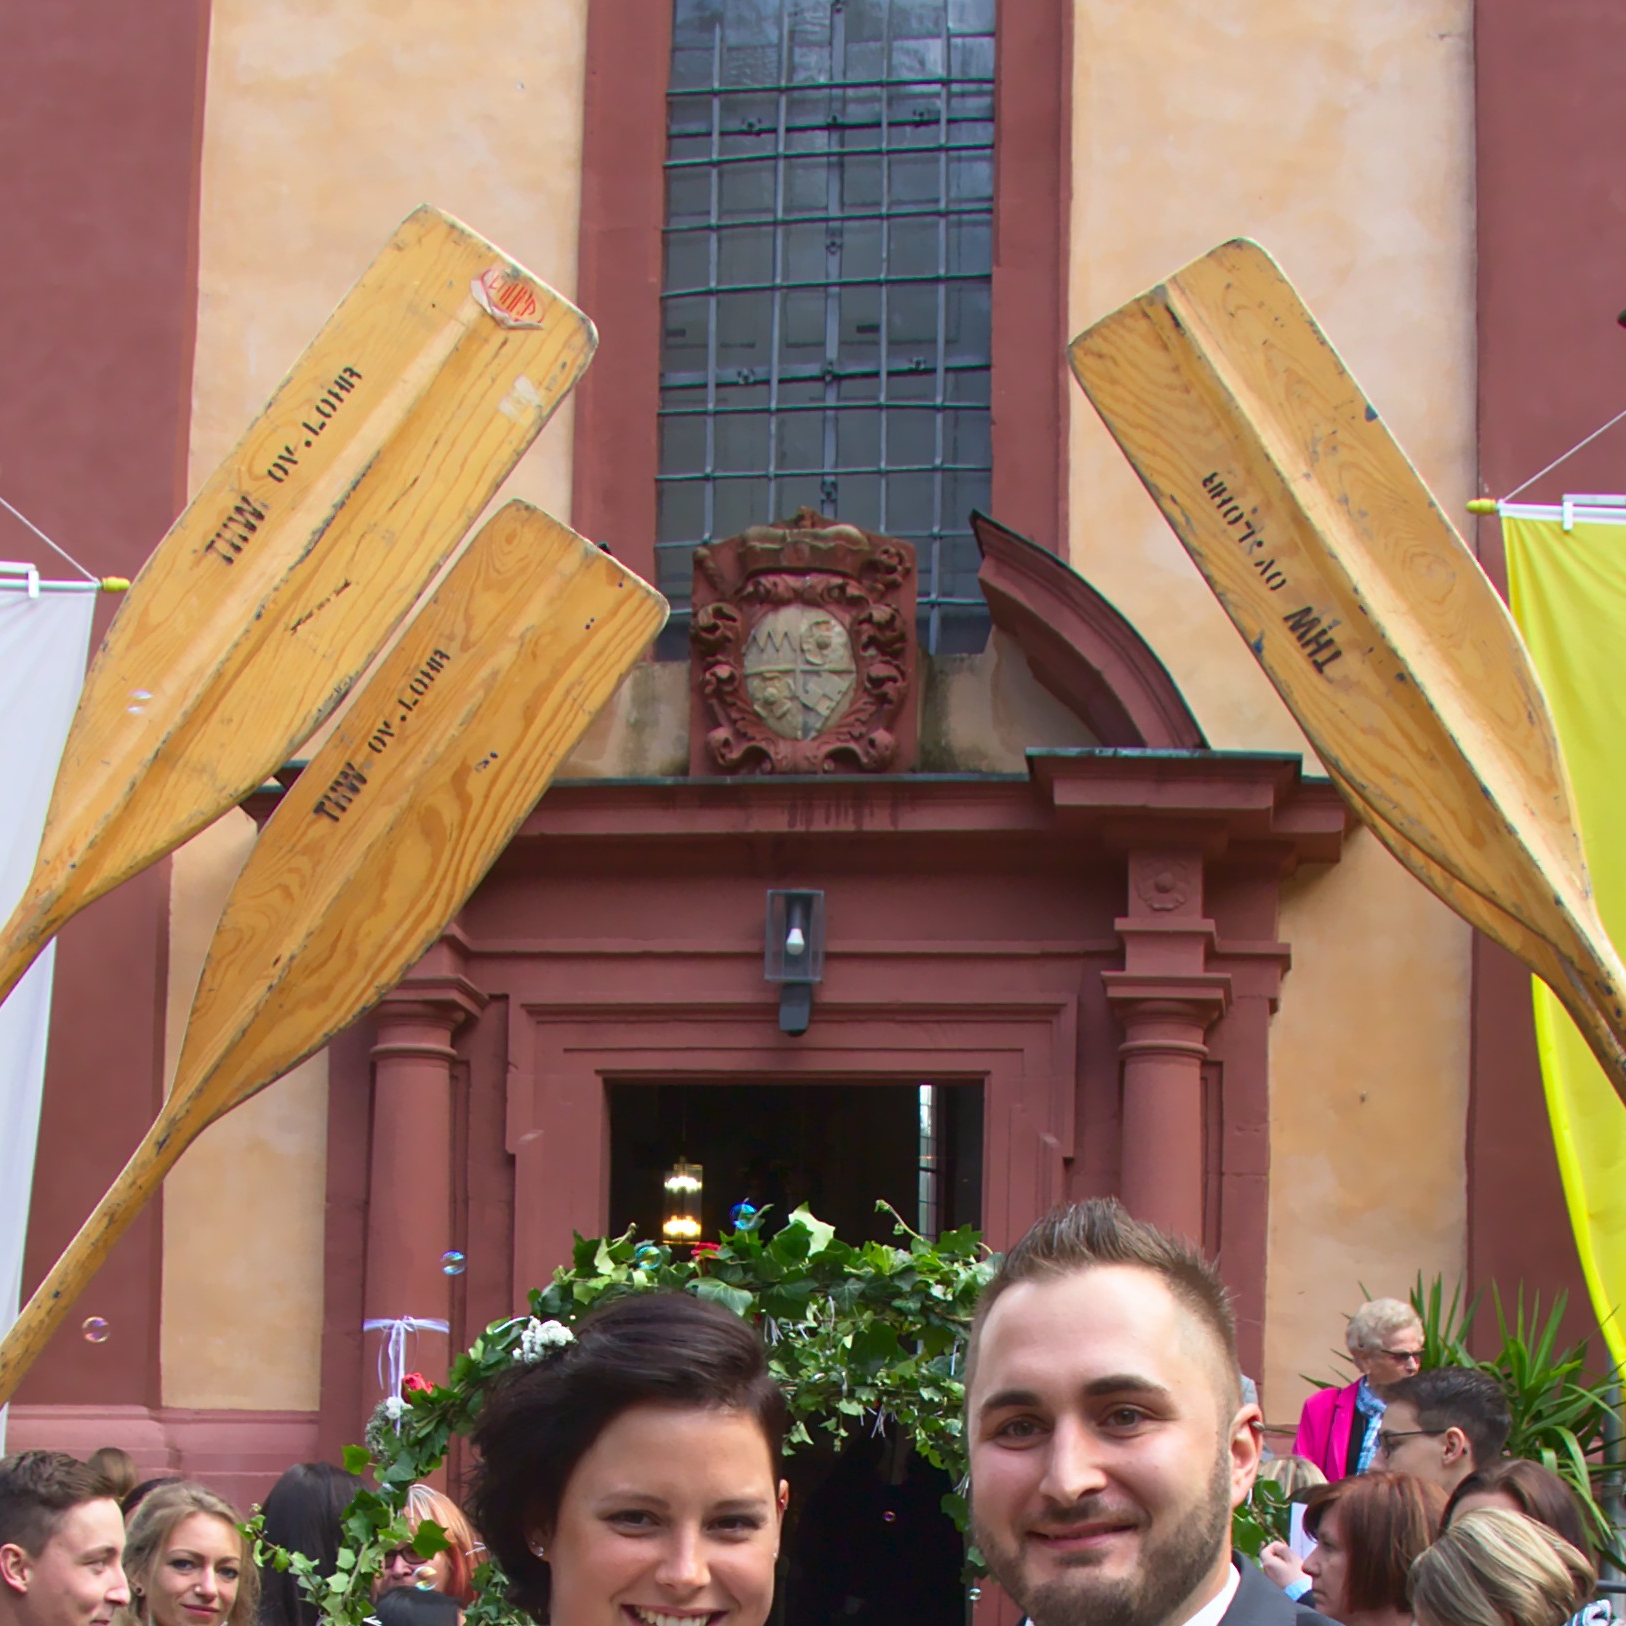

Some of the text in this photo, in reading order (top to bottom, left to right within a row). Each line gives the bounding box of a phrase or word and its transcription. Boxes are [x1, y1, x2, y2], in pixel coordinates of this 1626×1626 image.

[204, 495, 265, 565] THW
[1283, 606, 1342, 674] THW
[313, 761, 367, 822] THW
